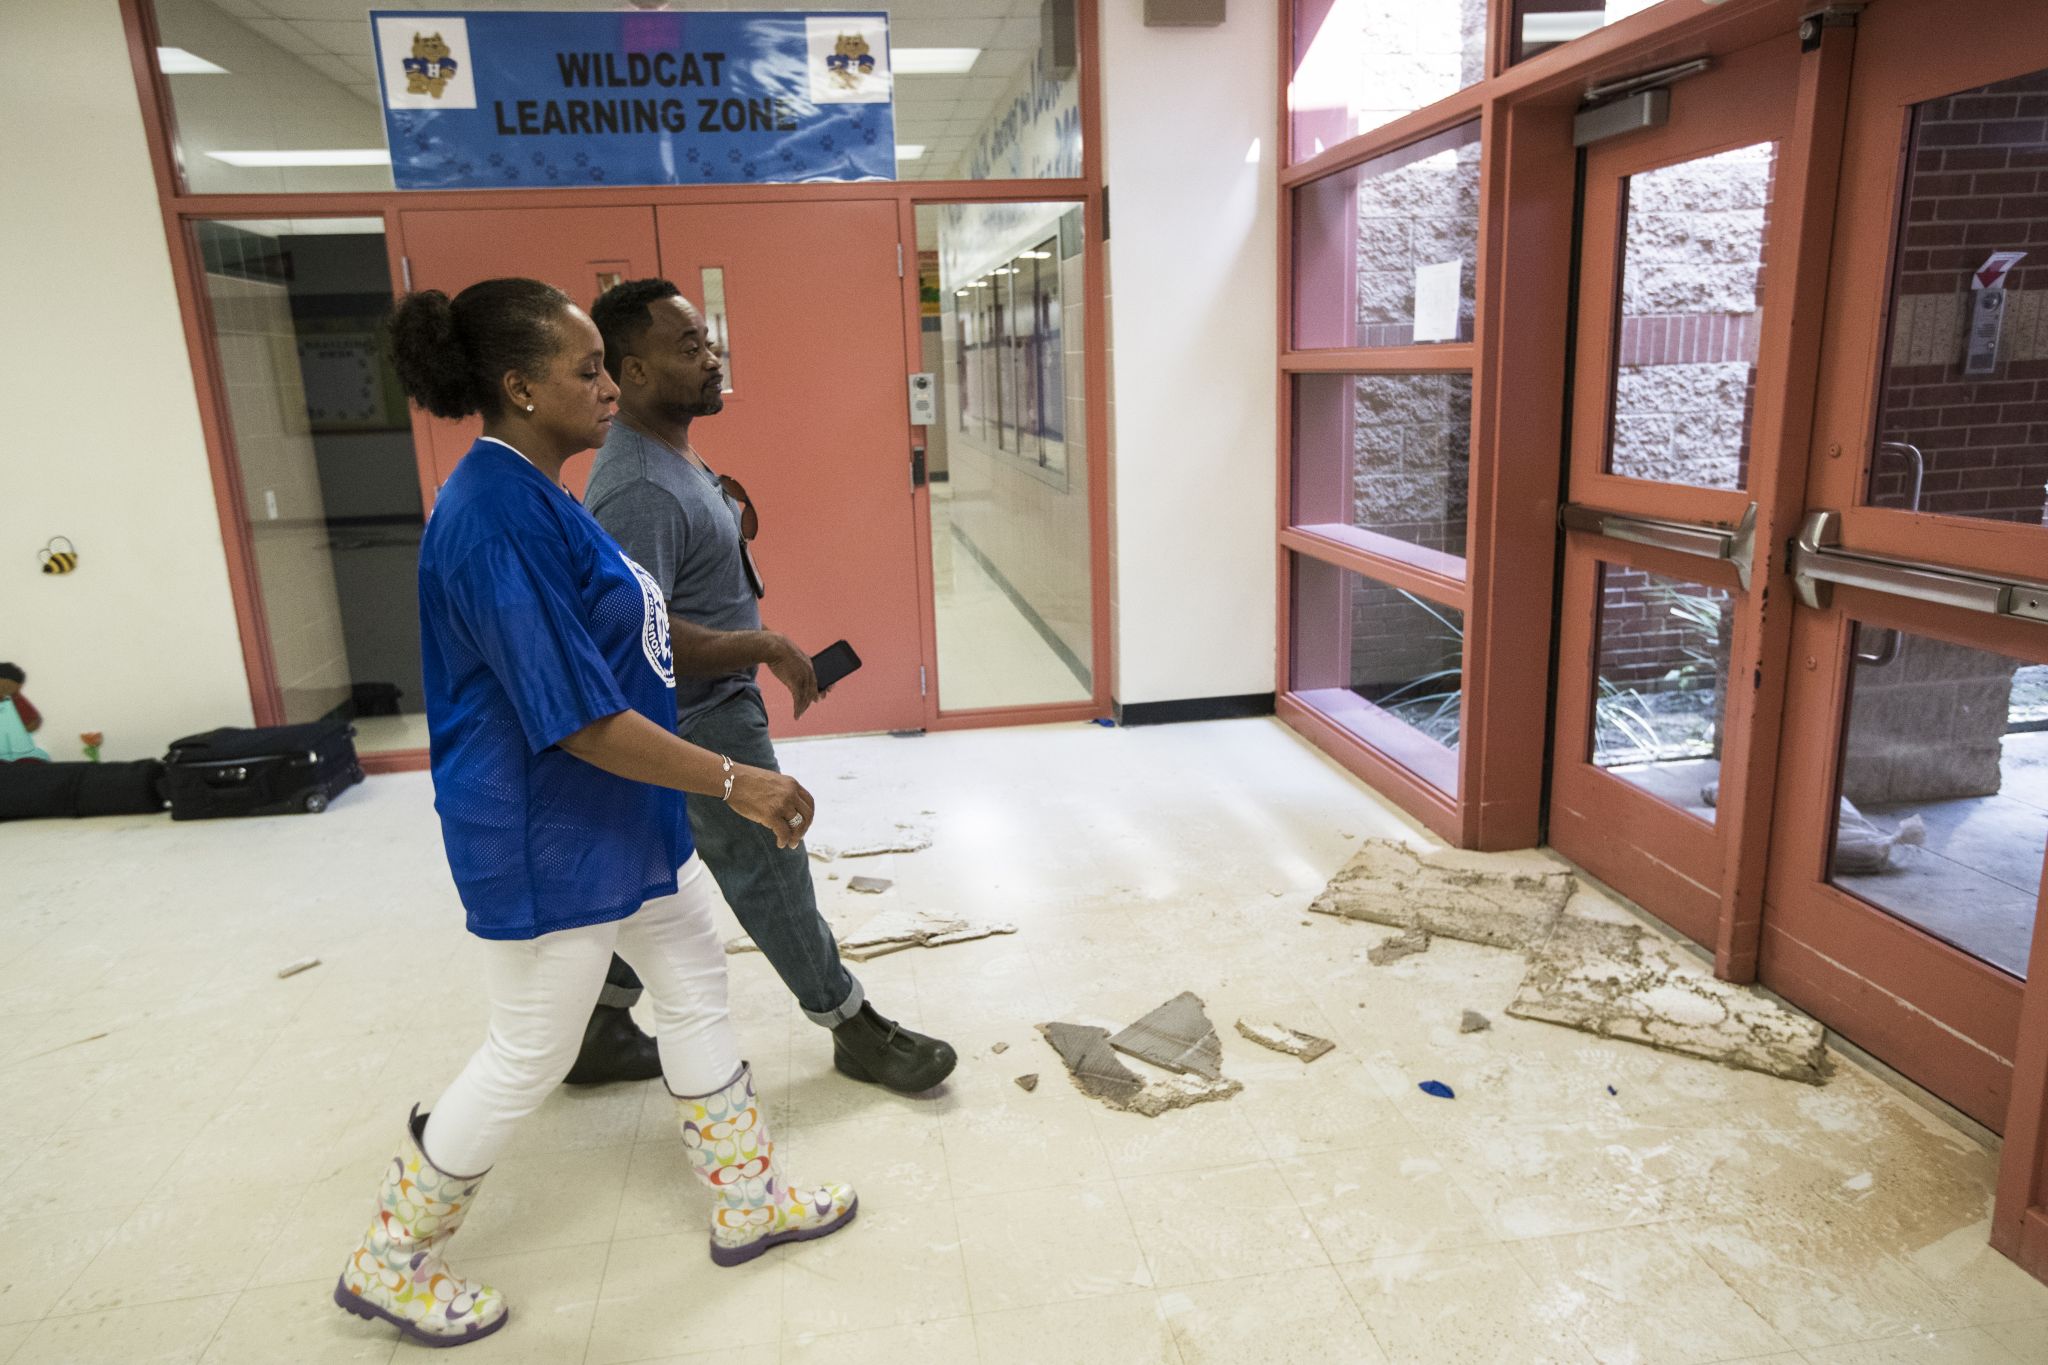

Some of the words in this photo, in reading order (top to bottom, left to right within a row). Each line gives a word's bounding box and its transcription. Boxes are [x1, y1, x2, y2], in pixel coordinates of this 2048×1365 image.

[427, 63, 441, 78] H
[556, 52, 726, 88] WILDCAT
[494, 98, 686, 135] LEARNING
[698, 97, 797, 132] ZONE
[648, 595, 662, 658] HOUSTON
